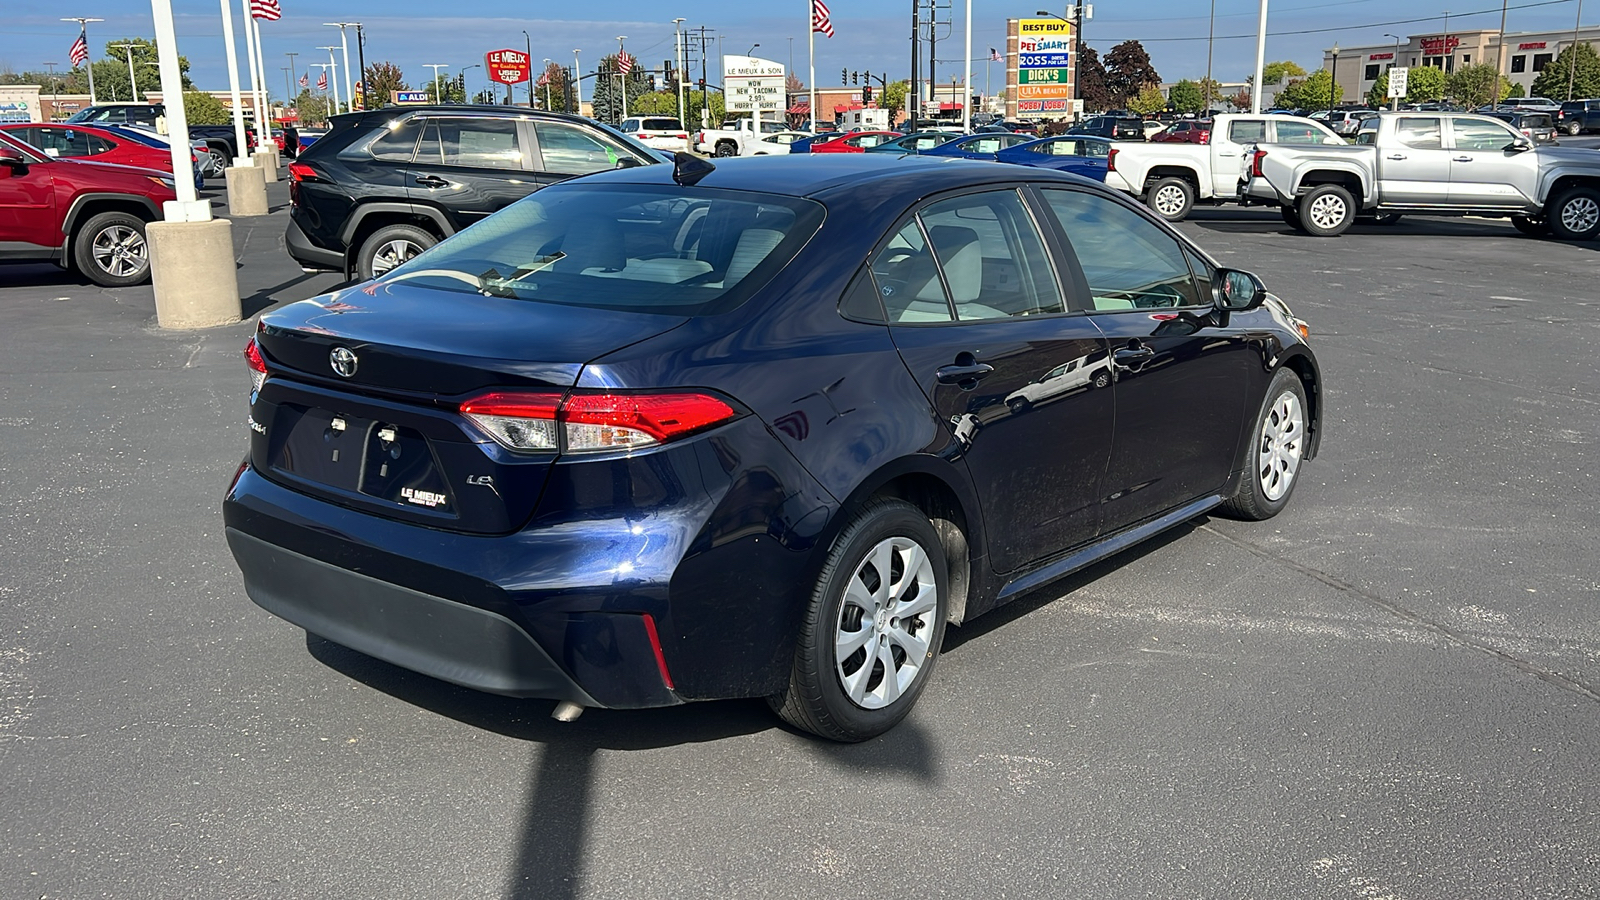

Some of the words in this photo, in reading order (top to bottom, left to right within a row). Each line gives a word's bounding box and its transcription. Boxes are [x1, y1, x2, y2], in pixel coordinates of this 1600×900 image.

[1021, 40, 1068, 52] PETSMART
[490, 54, 500, 62] LE
[502, 52, 526, 63] MIEUX
[1020, 56, 1047, 66] ROSS
[1028, 70, 1059, 80] DICK'S
[1020, 87, 1041, 97] ULTA
[1018, 102, 1042, 110] HOBBY
[1044, 101, 1066, 109] LOBBY
[401, 487, 414, 498] LE
[414, 489, 446, 504] MIEUX
